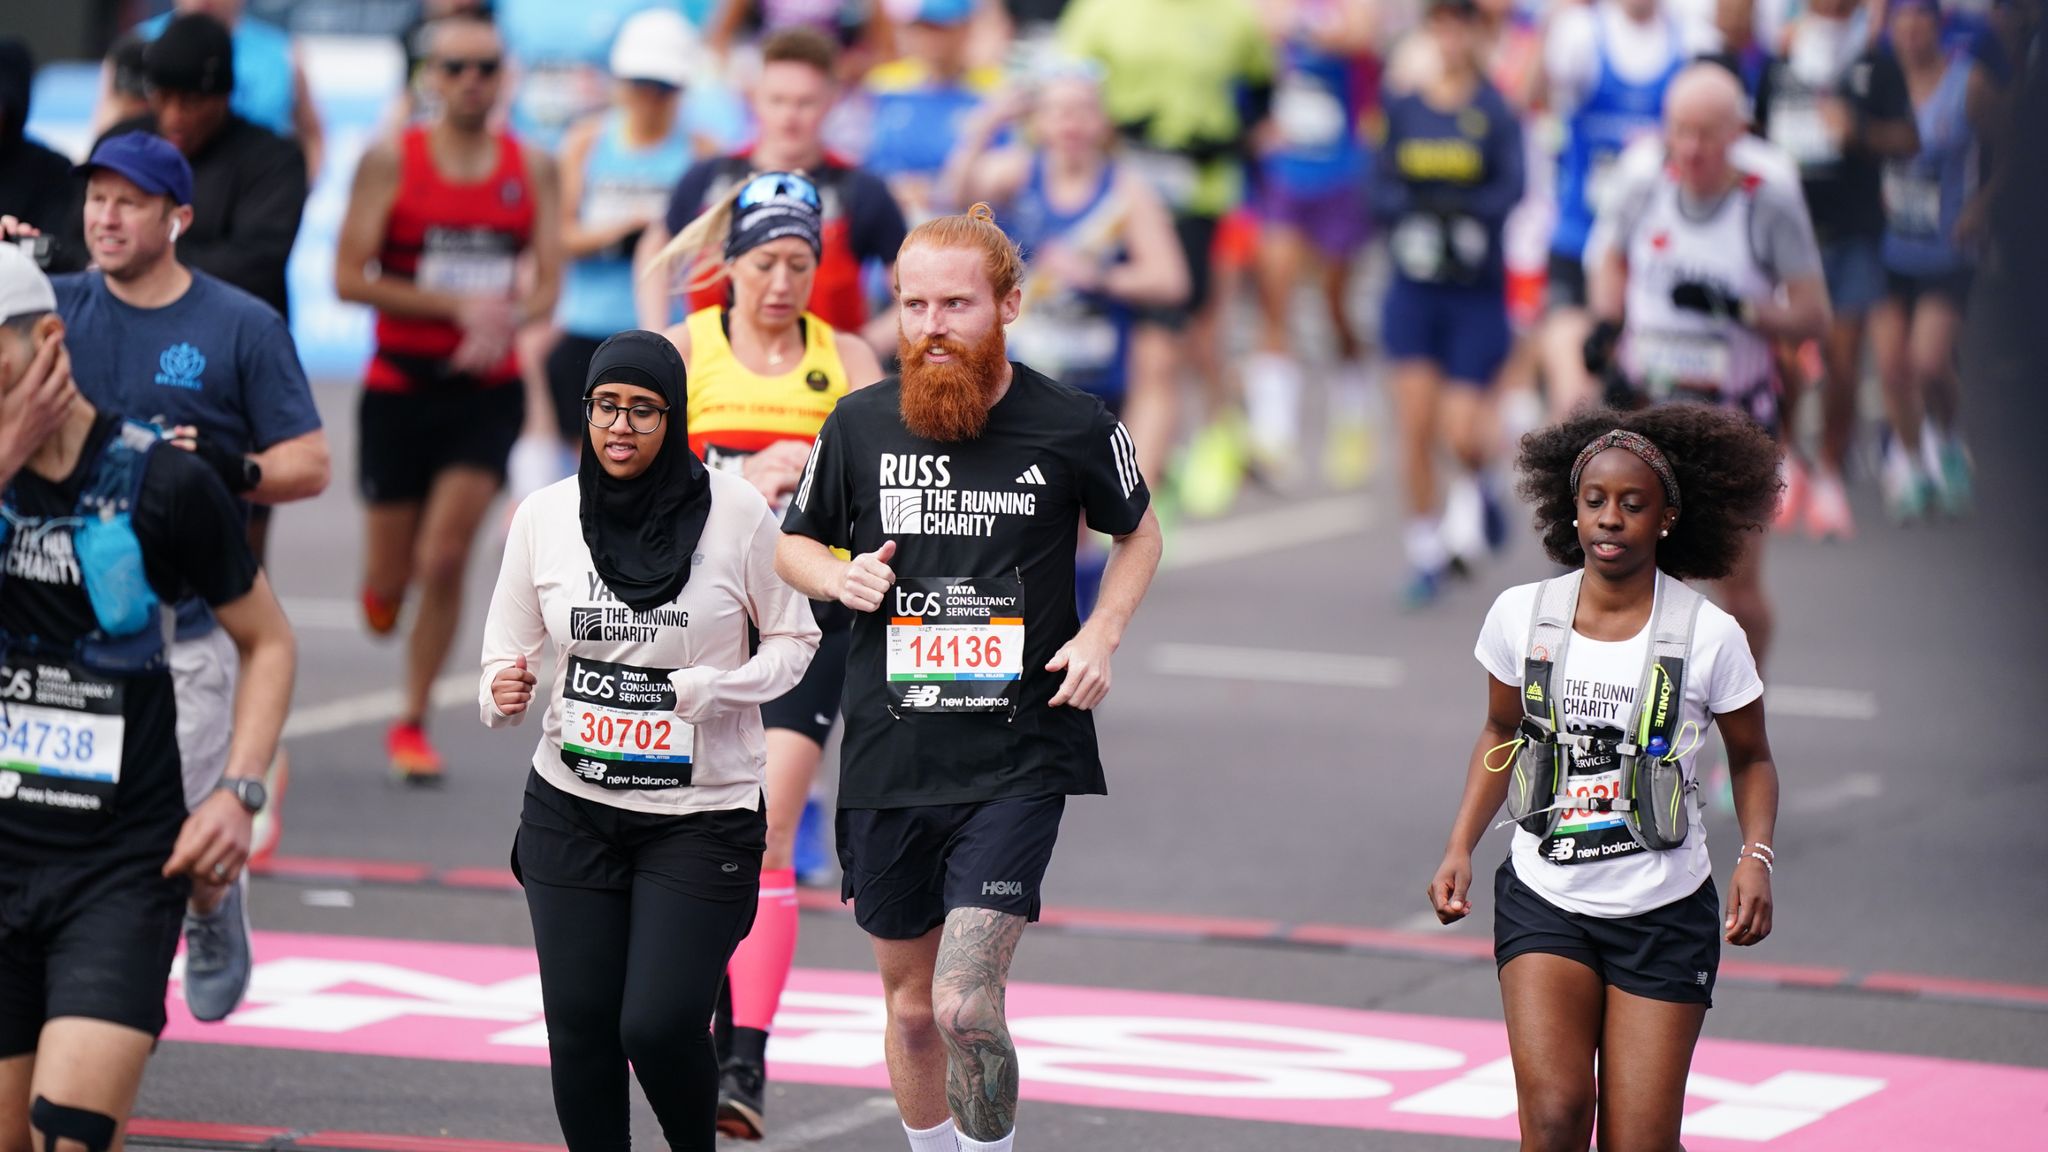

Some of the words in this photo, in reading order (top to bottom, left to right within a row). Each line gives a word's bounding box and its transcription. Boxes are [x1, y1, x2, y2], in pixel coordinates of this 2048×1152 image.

[879, 453, 950, 488] RUSS
[925, 489, 957, 512] THE
[960, 490, 1036, 516] RUNNING
[923, 512, 996, 537] CHARITY
[946, 586, 976, 595] TATA
[946, 597, 1017, 607] CONSULTANCY
[604, 607, 629, 624] THE
[632, 609, 689, 628] RUNNING
[946, 608, 991, 617] SERVICES
[604, 625, 658, 643] CHARITY
[910, 635, 1002, 668] 14136
[621, 671, 649, 682] TATA
[619, 692, 662, 704] SERVICES
[1566, 679, 1589, 698] THE
[1592, 682, 1637, 704] RUNNI
[940, 698, 963, 707] new
[965, 695, 1010, 707] balance
[1563, 697, 1619, 720] CHARITY
[580, 712, 672, 751] 30702
[606, 775, 631, 785] new
[632, 774, 679, 786] balance
[1576, 847, 1600, 859] new
[981, 880, 1023, 896] HOKA
